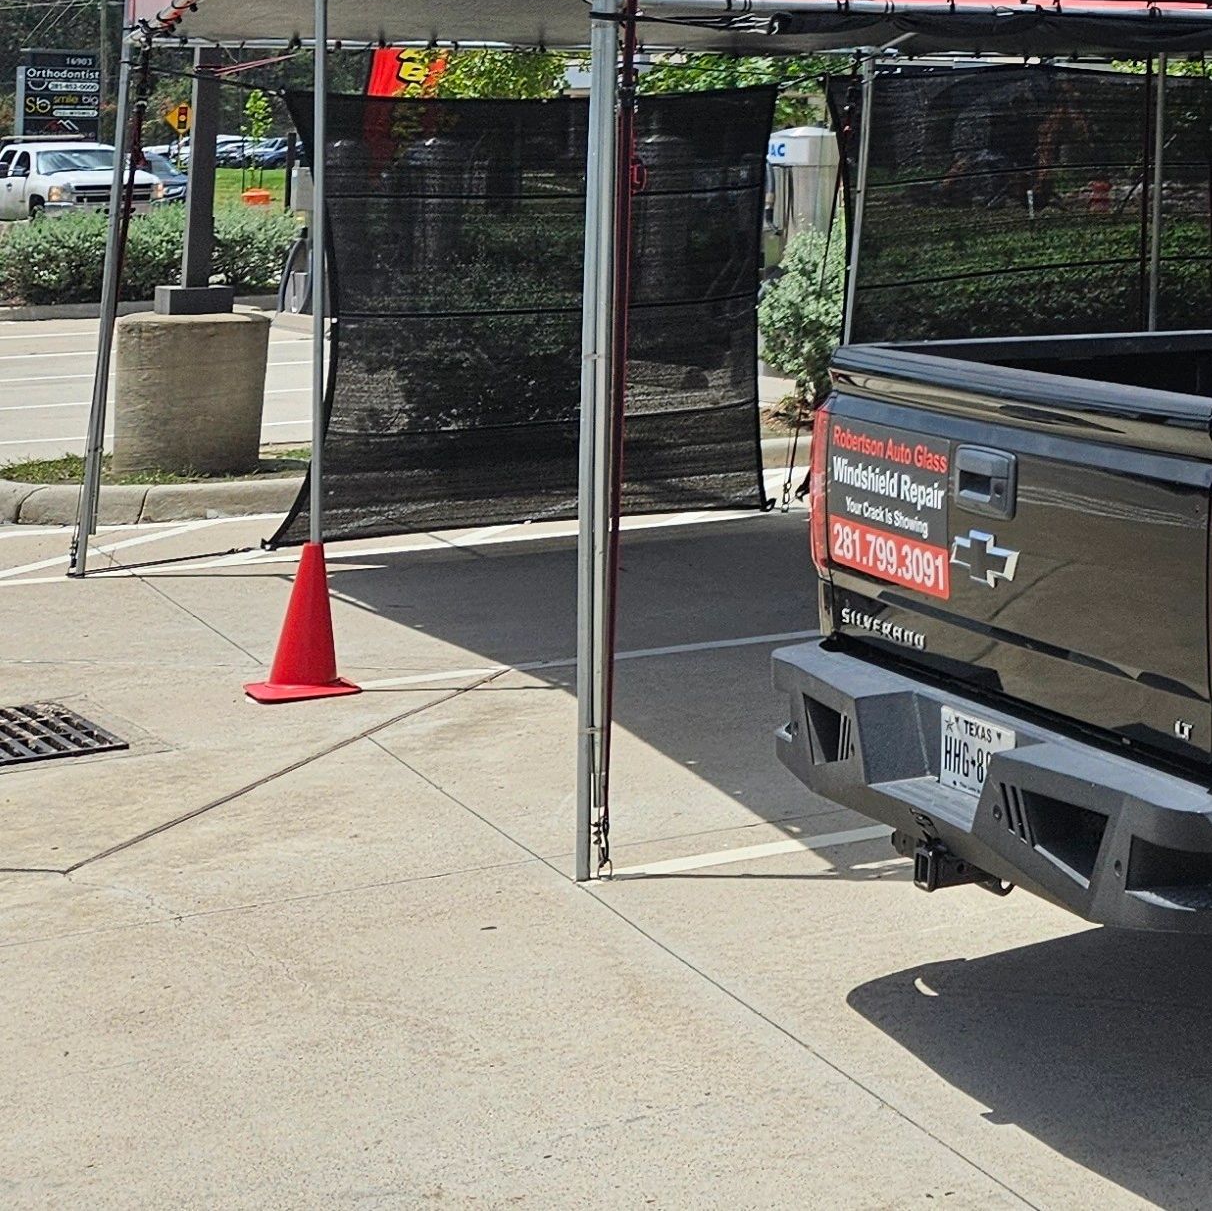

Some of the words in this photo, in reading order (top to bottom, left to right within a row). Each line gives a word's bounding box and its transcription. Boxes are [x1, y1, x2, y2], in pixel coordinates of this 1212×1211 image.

[27, 68, 99, 79] Orthodontist
[833, 425, 885, 460] Robertson
[885, 438, 912, 465] Auto
[914, 445, 948, 474] Glass
[833, 456, 899, 499] Windshield
[900, 474, 945, 510] Repair
[845, 496, 862, 516] Your
[863, 502, 885, 524] Crack
[884, 508, 893, 525] Is
[893, 510, 929, 540] Showing
[833, 522, 944, 591] 281.799.3091
[841, 607, 926, 650] SILVERADO
[964, 720, 992, 743] TEXAS
[1174, 720, 1193, 741] LT
